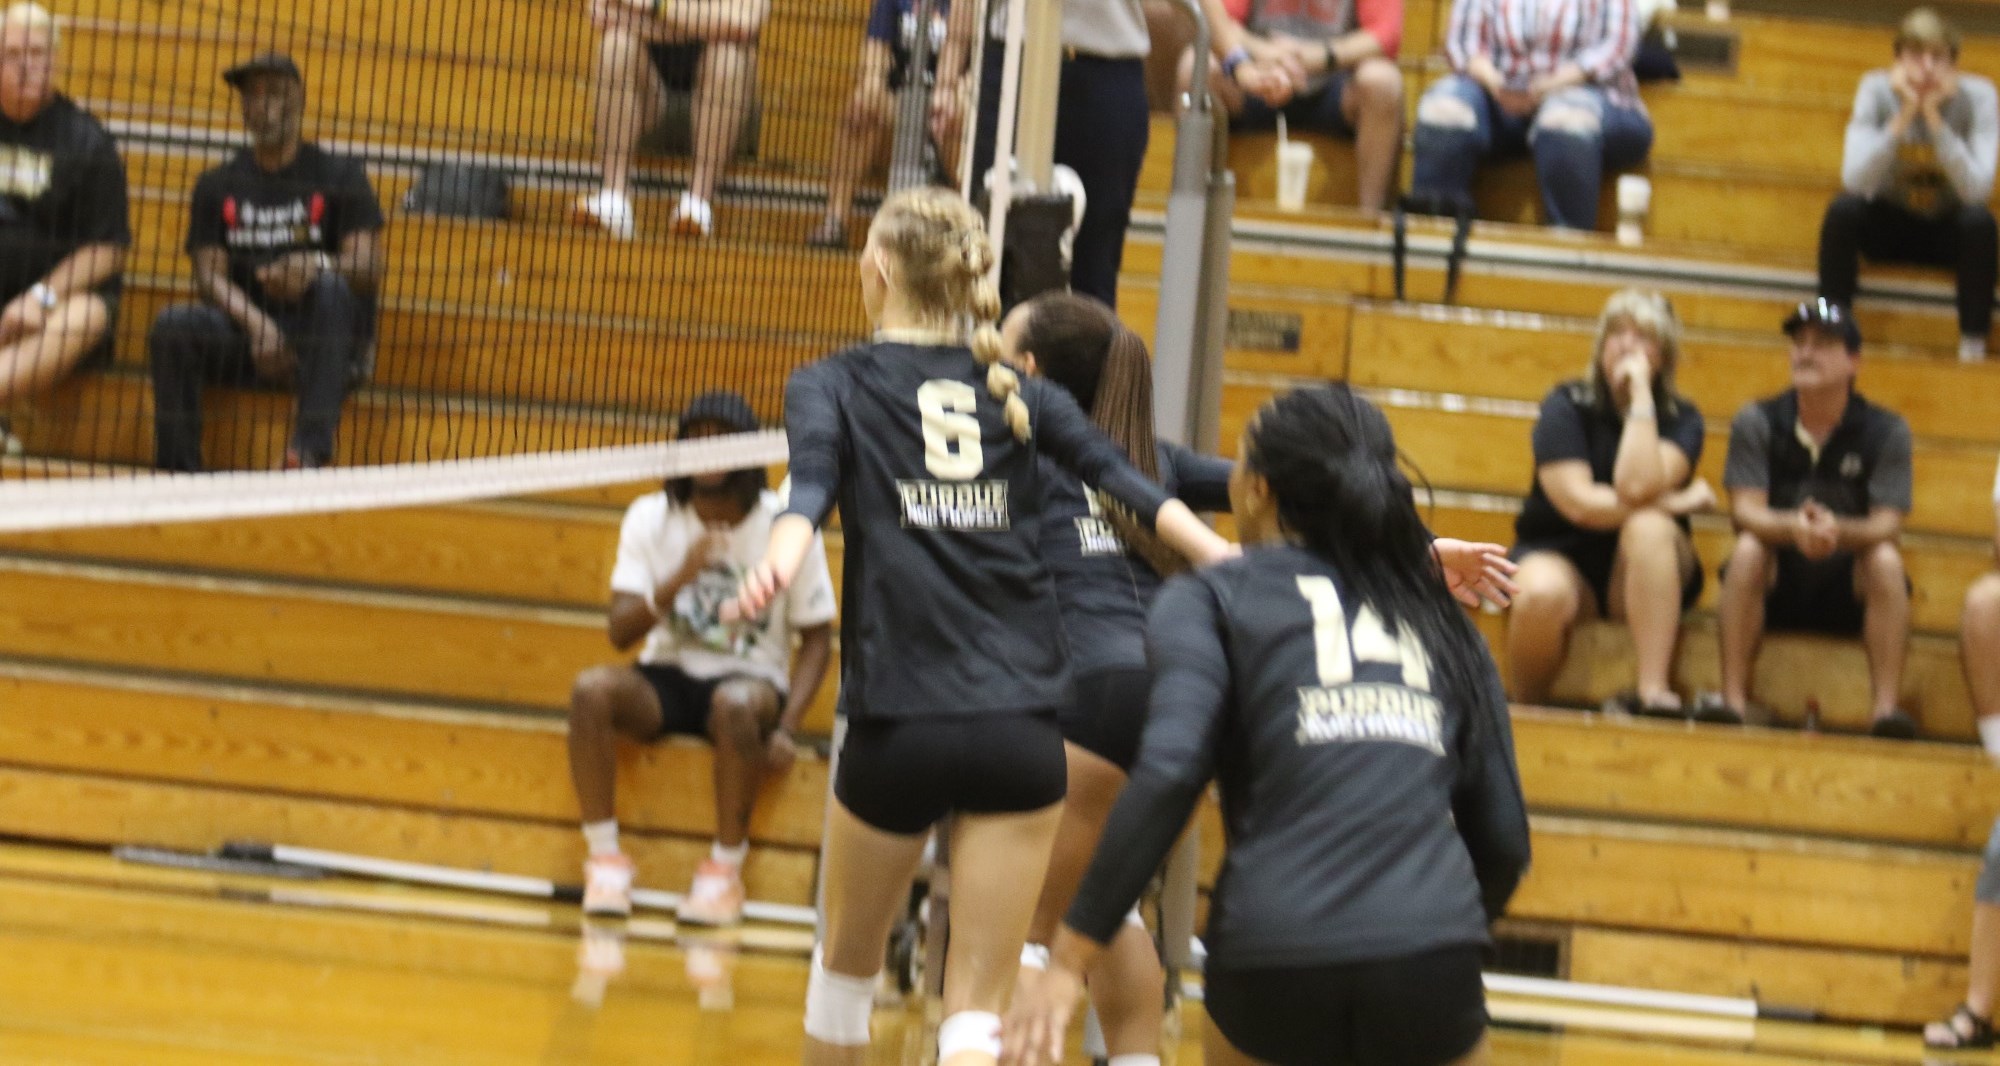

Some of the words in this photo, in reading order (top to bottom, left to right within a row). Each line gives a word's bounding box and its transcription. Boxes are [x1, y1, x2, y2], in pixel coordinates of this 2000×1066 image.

[917, 379, 983, 480] 6
[902, 483, 1006, 510] PURDUE
[1296, 574, 1434, 692] 14
